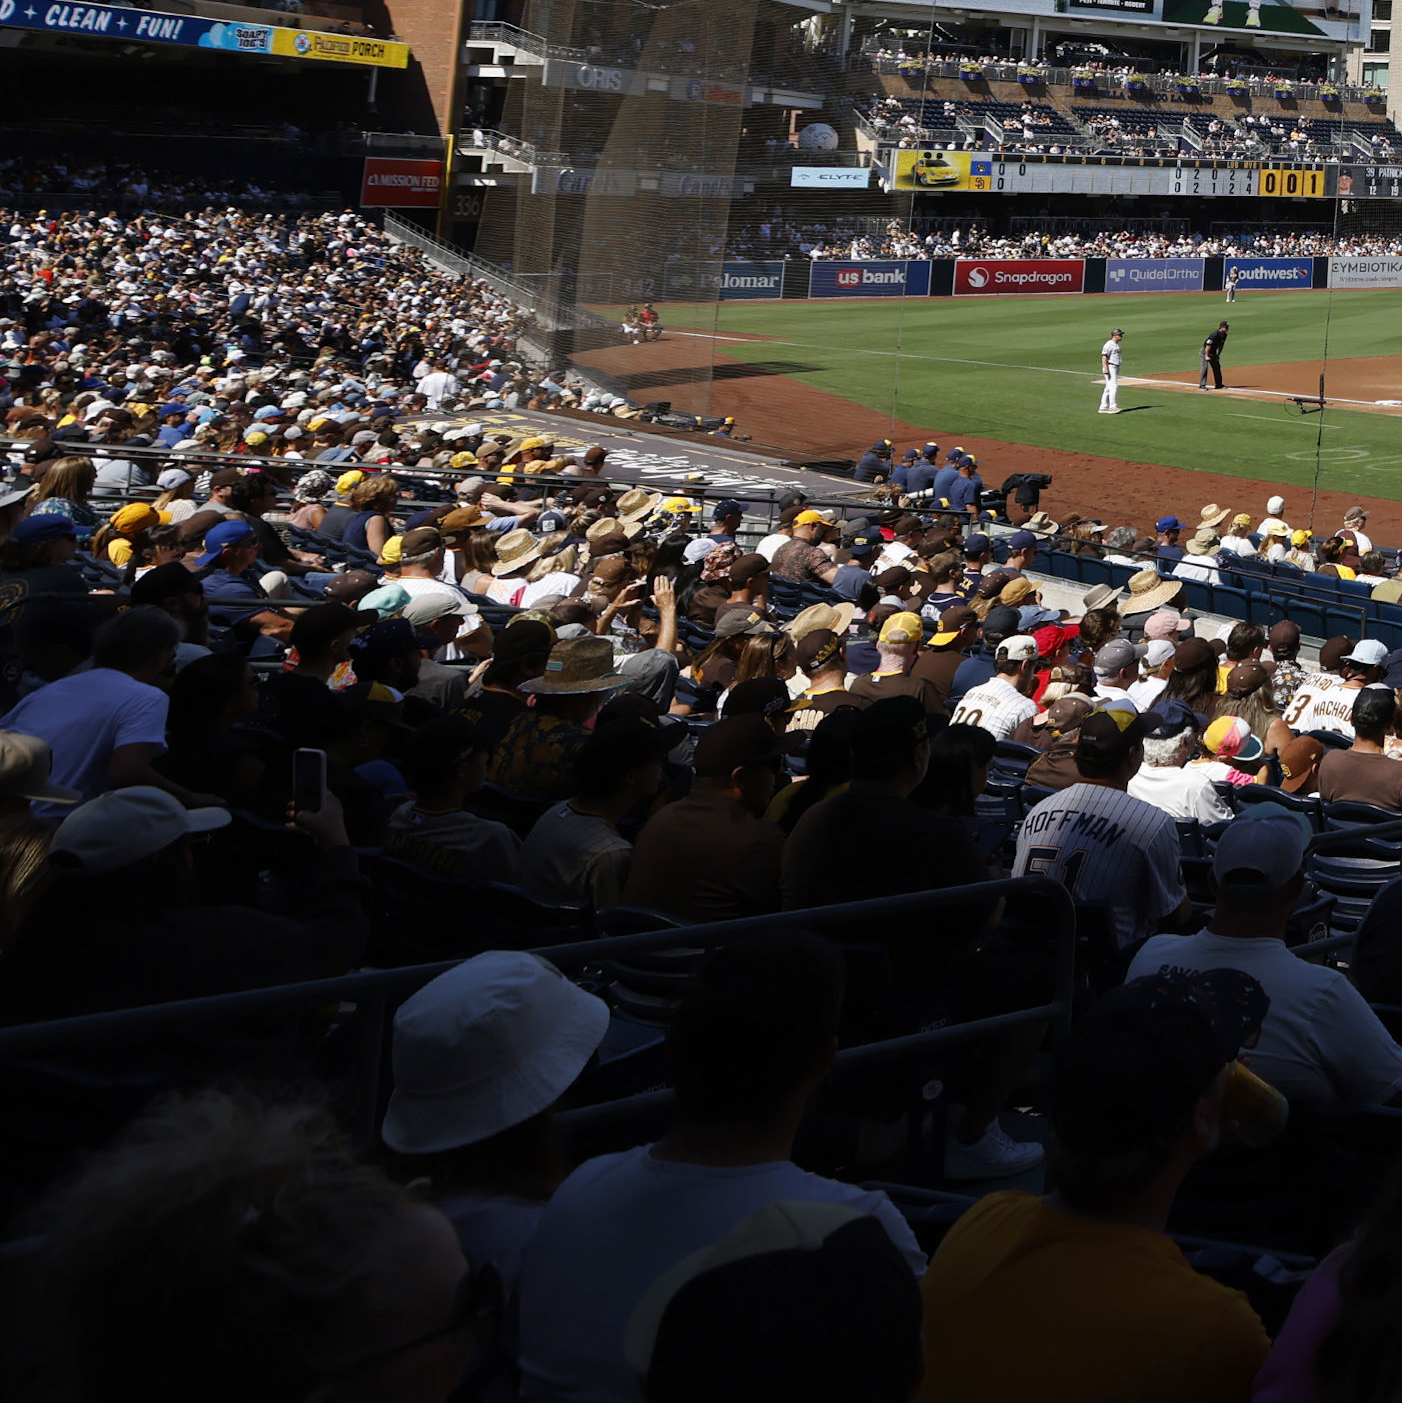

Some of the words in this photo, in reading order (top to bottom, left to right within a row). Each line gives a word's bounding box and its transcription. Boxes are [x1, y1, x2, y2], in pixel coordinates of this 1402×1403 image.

[45, 3, 111, 32] CLEAN
[136, 15, 183, 41] FUN!
[352, 40, 385, 58] PORCH
[380, 174, 420, 188] MISSION
[421, 176, 440, 188] FED
[455, 194, 481, 216] 336
[837, 274, 859, 287] us
[863, 269, 906, 284] bank
[994, 271, 1072, 286] Snapdragon
[1130, 268, 1201, 281] QuidelOrtho
[1236, 267, 1298, 280] outhwest
[1024, 809, 1126, 847] HOFFMAN
